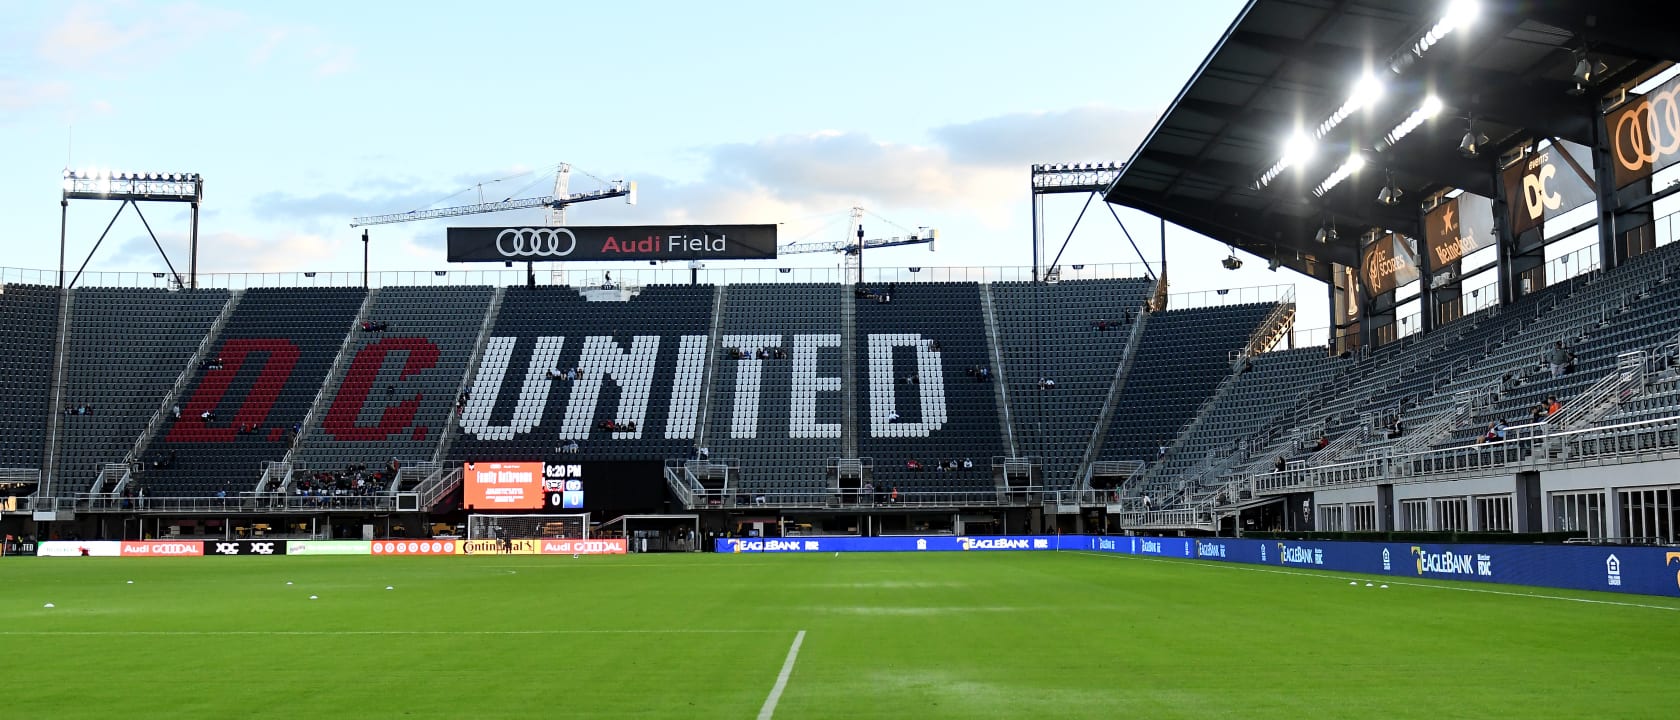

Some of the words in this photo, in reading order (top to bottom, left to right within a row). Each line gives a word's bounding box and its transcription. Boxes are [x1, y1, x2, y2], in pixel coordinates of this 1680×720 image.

[1523, 164, 1561, 220] DC
[601, 236, 660, 253] Audi
[668, 234, 726, 252] Field
[1435, 235, 1479, 265] Heineken
[1380, 254, 1405, 276] SCORES
[459, 334, 948, 441] UNITED
[546, 464, 566, 477] 6:20
[566, 464, 582, 477] PM
[552, 493, 560, 506] 0
[571, 493, 579, 506] 0
[12, 543, 34, 552] UTED
[124, 544, 149, 553] Audi
[463, 540, 523, 553] Continal
[544, 542, 571, 552] Audi
